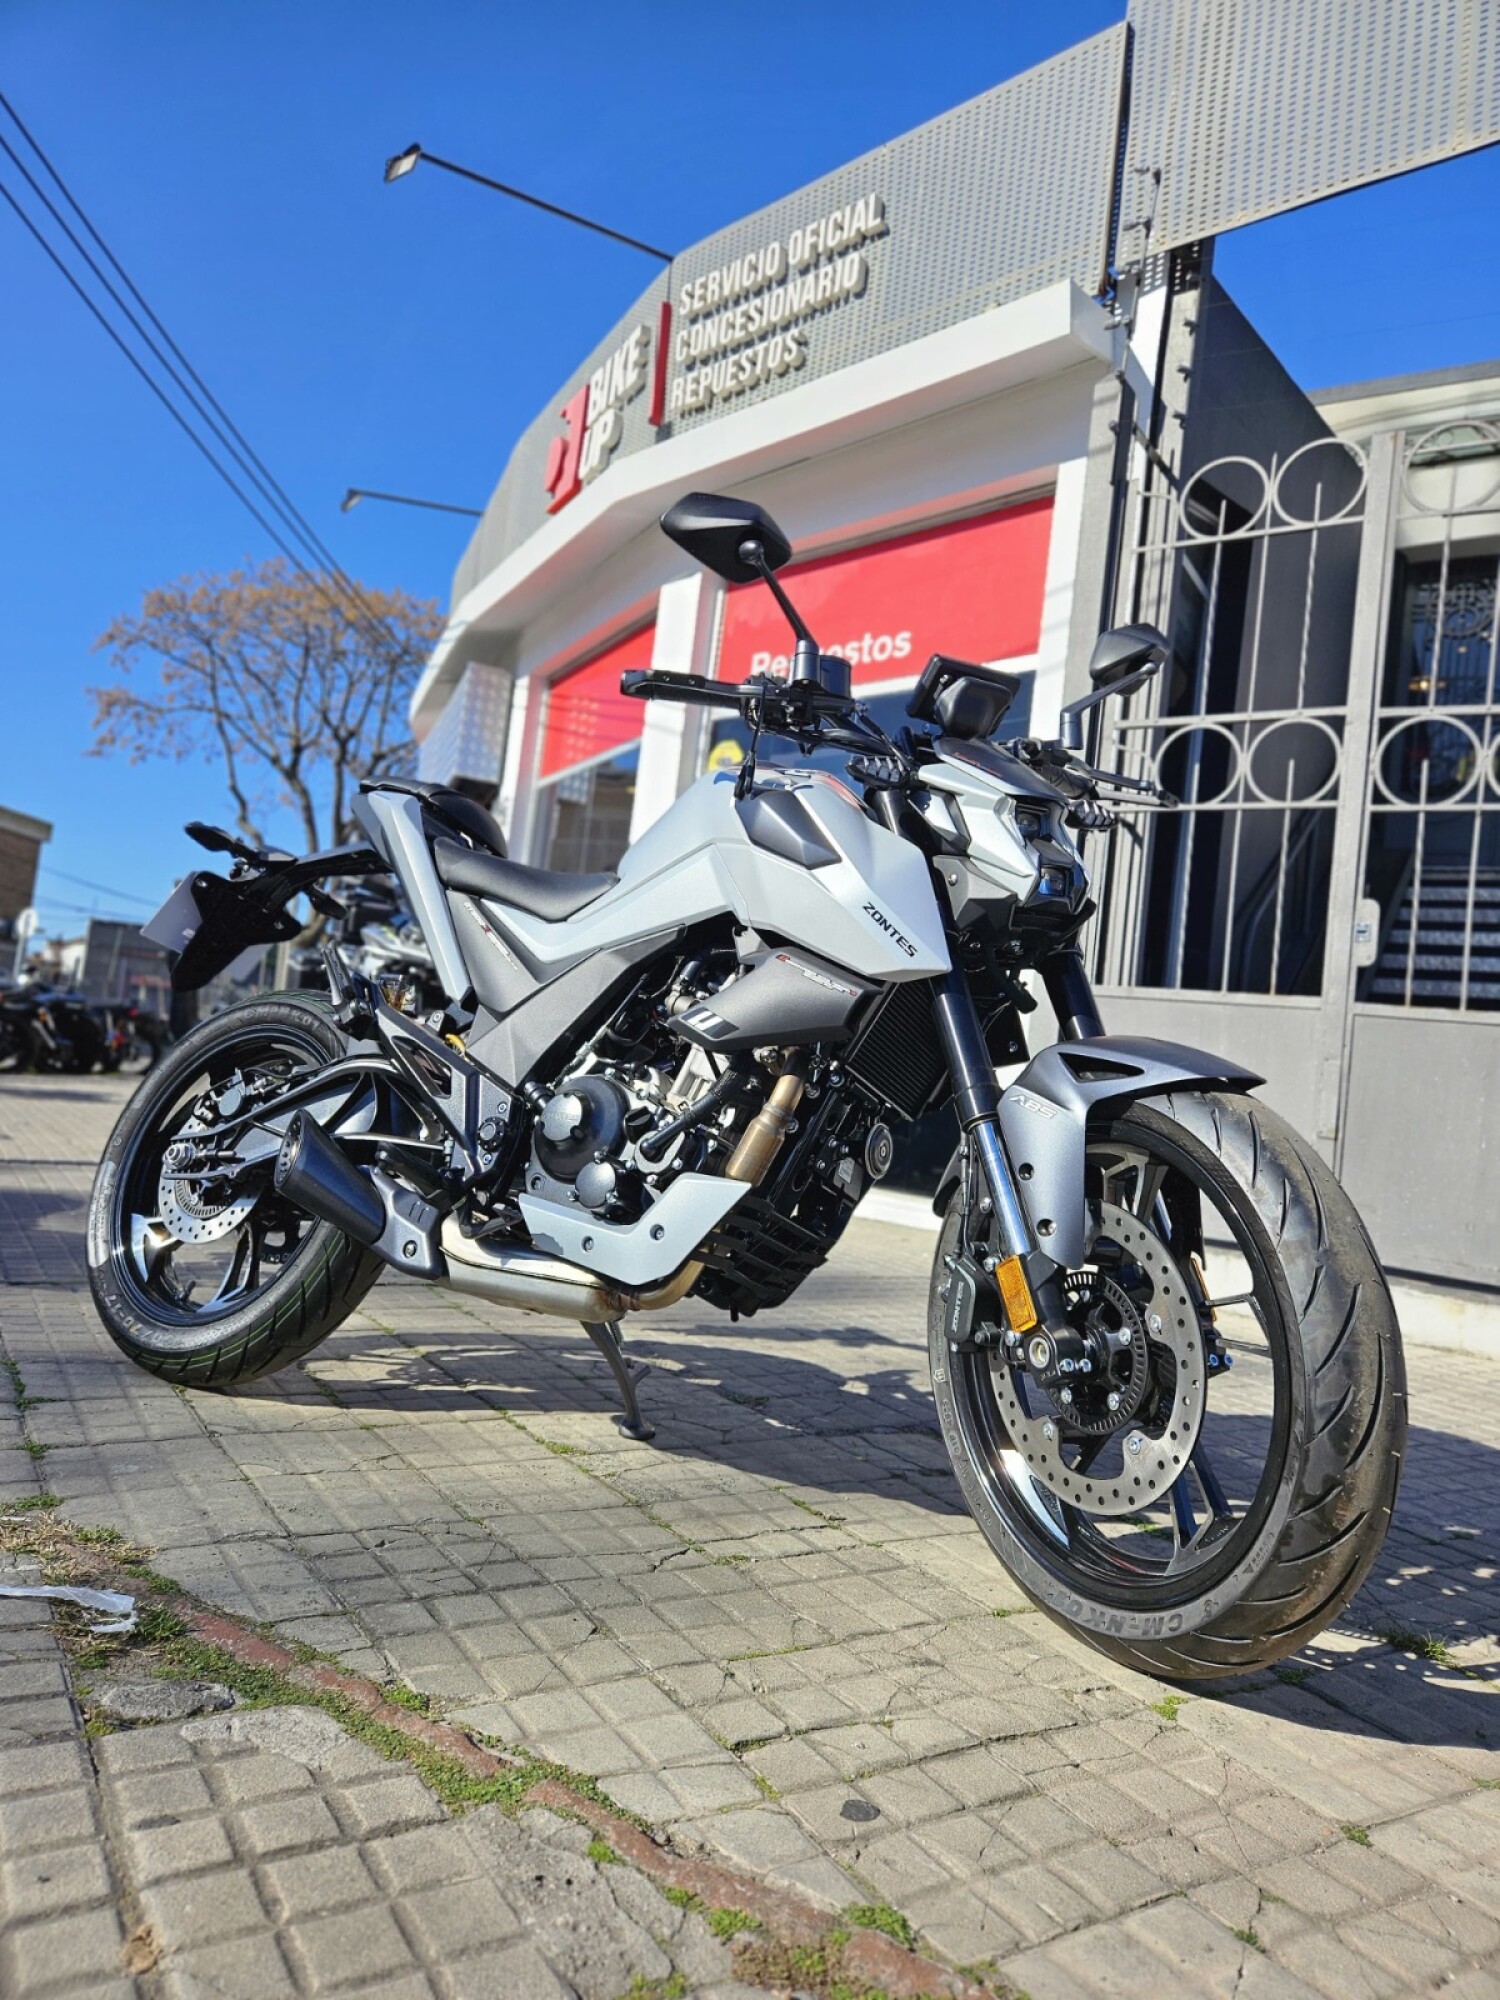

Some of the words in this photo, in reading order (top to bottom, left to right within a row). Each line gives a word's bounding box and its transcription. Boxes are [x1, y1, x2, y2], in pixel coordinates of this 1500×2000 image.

[679, 242, 783, 316] SERVICIO
[788, 193, 883, 266] OFICIAL
[675, 252, 864, 363] CONCESIONARIO
[587, 325, 648, 427] BIKE
[670, 329, 803, 411] REPUESTOS
[578, 411, 620, 481] UP
[752, 631, 912, 678] Restos
[862, 901, 919, 958] ZONTES
[1009, 1093, 1058, 1120] ABS
